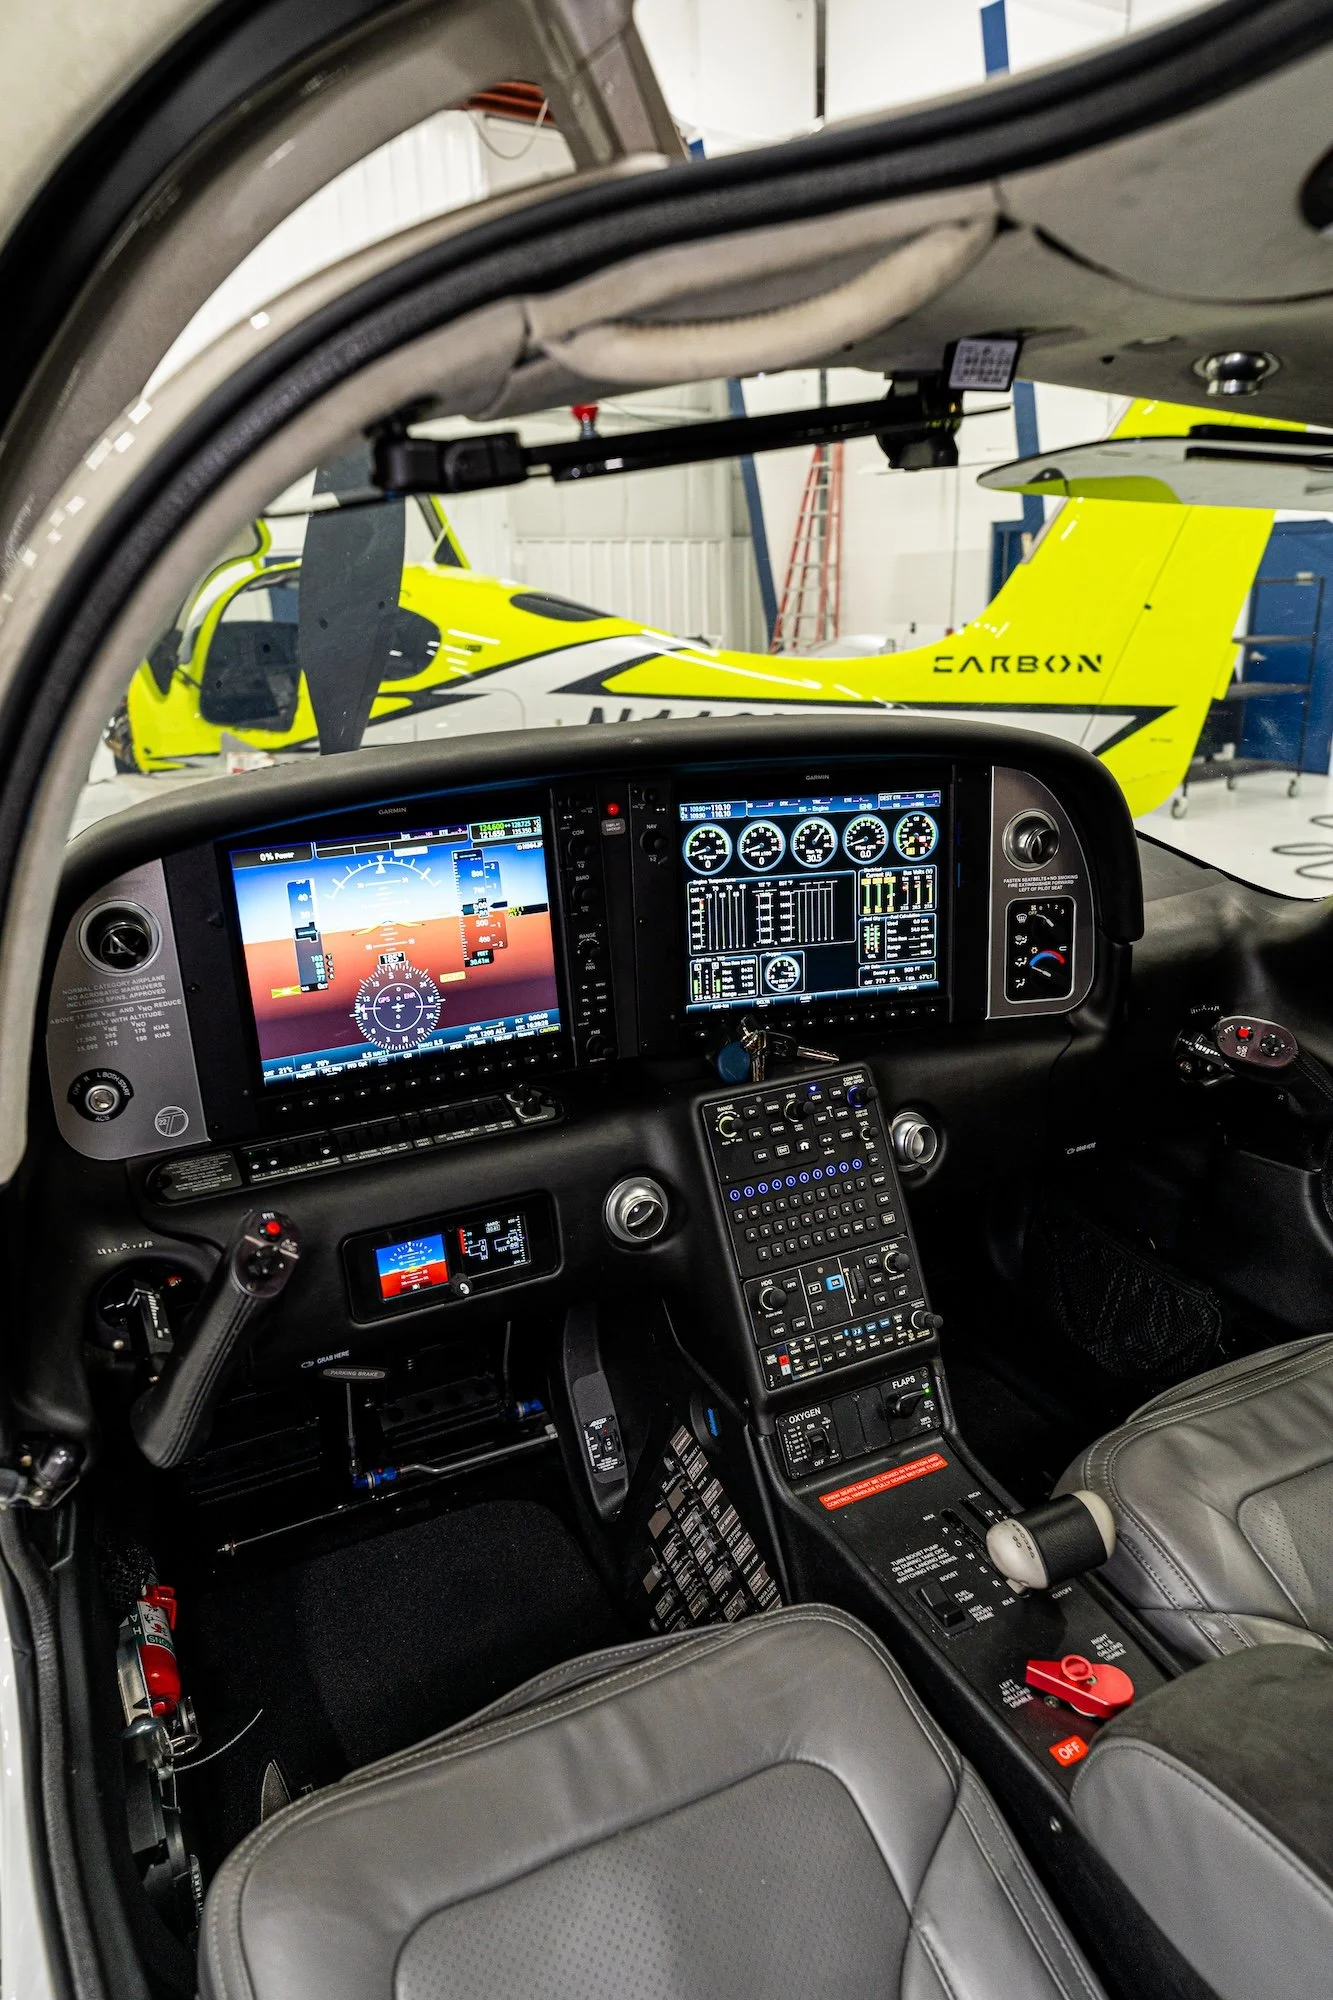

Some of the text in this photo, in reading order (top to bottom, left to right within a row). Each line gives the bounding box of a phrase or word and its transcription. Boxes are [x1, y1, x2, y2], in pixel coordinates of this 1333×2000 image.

[933, 654, 1102, 674] CARBON
[378, 807, 407, 815] GARMIN
[711, 804, 731, 812] 110.10
[479, 823, 504, 832] 124.600
[480, 830, 505, 839] 121.650
[274, 851, 295, 860] Power
[806, 854, 822, 862] 30.5
[860, 850, 872, 858] 0.0
[476, 919, 489, 927] 500
[62, 974, 166, 995] NORMAL CATEGORY AIRPLANE
[80, 988, 119, 999] ACROBATIC
[120, 982, 163, 993] MANEUVERS
[66, 988, 166, 1008] INCLUDING APPROVED
[50, 1016, 74, 1024] ABOVE
[153, 999, 182, 1008] REDUCE
[75, 1020, 109, 1029] LINEARLY
[129, 1011, 165, 1020] ALTITUDE:
[154, 1031, 171, 1039] KIAS
[539, 1025, 559, 1034] CAUTION
[1224, 1024, 1235, 1034] PTT
[102, 1071, 130, 1096] BOTH START
[717, 1104, 734, 1112] RANGE
[760, 1279, 773, 1287] HDG
[316, 1350, 350, 1364] GRAB HERE
[892, 1376, 916, 1389] FLAPS
[788, 1407, 822, 1424] OXYGEN
[814, 1459, 825, 1467] OFF
[824, 1493, 840, 1502] CREW
[840, 1486, 857, 1497] SEATS
[856, 1480, 871, 1491] MUST
[879, 1471, 900, 1482] LOCKED
[904, 1460, 928, 1472] POSITION
[826, 1460, 944, 1508] CONTROL HANDLES FULLY DOWN BEFORE FLIGHT
[967, 1490, 982, 1499] RICH
[890, 1543, 939, 1567] TURN BOOST PUMP
[900, 1558, 922, 1569] DURING
[921, 1552, 935, 1560] TAKE
[915, 1552, 950, 1569] LANDING AND
[896, 1563, 940, 1584] SWITCHING FUEL
[939, 1570, 959, 1582] BOOST
[954, 1589, 969, 1598] FUEL
[959, 1592, 975, 1604] PUMP
[1052, 1586, 1072, 1599] CUTOFF
[1001, 1597, 1016, 1606] IDLE
[968, 1604, 984, 1614] HIGH
[976, 1612, 995, 1623] PRIME
[1090, 1634, 1109, 1645] RIGHT
[1096, 1642, 1124, 1657] GALLONS
[1103, 1648, 1127, 1662] USABLE
[999, 1679, 1015, 1689] LEFT
[1002, 1687, 1031, 1704] GALLONS
[1008, 1693, 1034, 1709] USABLE
[1058, 1741, 1080, 1760] OFF
